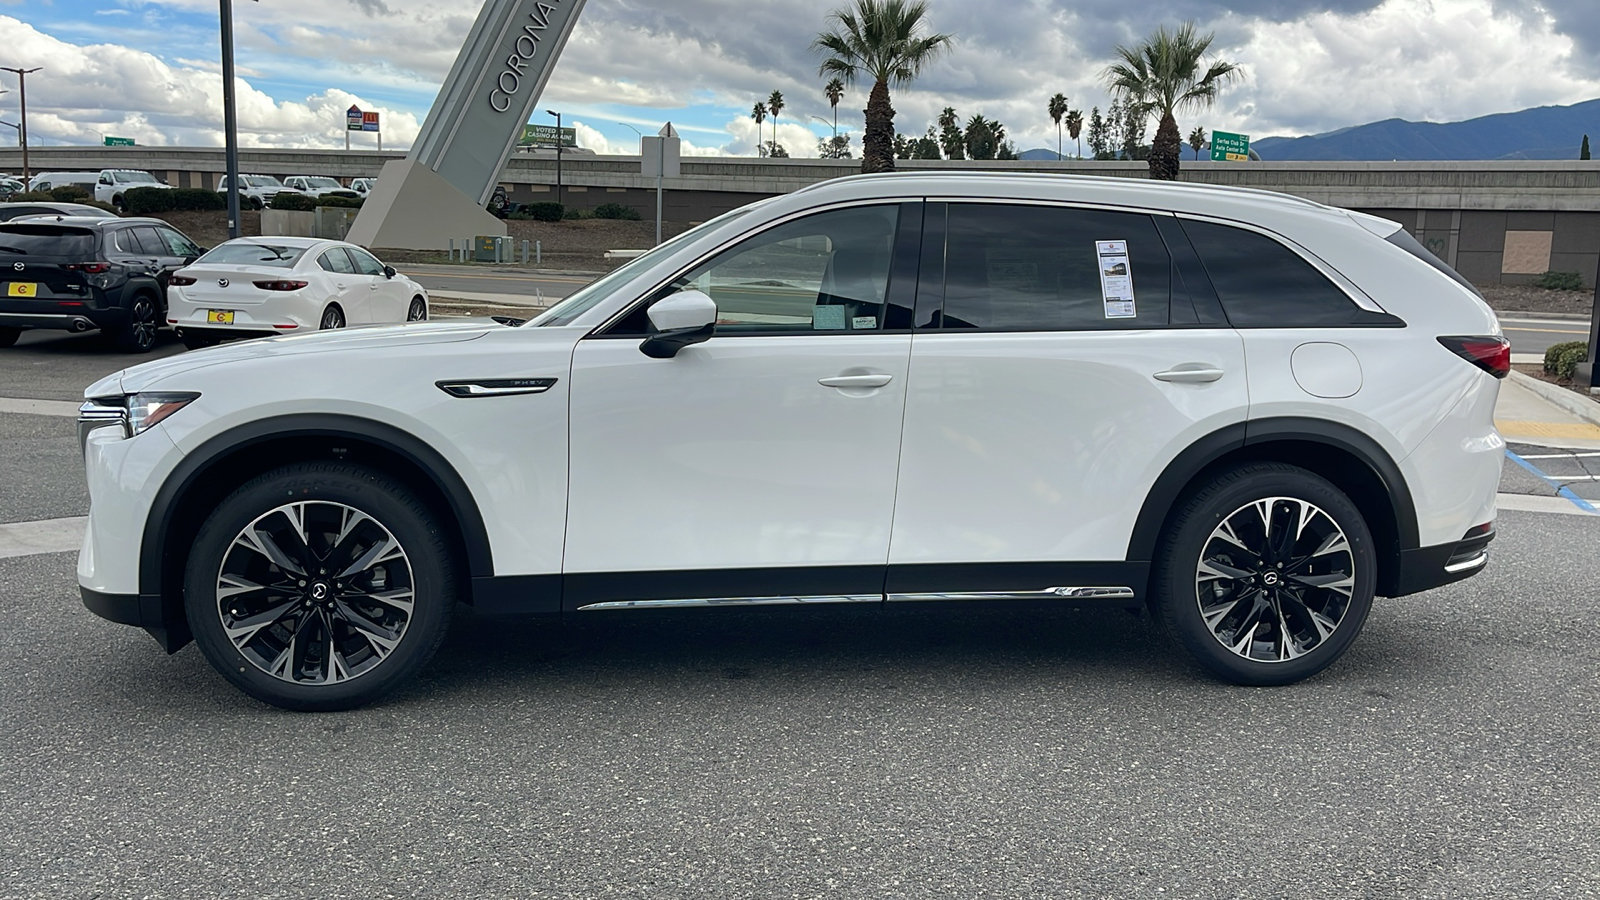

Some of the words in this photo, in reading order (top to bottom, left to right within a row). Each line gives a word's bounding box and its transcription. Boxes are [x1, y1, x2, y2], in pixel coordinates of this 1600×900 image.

[489, 1, 557, 112] CORONA
[535, 126, 557, 134] VOTED
[527, 131, 551, 139] CASINO
[1216, 137, 1230, 145] Serfas
[1226, 145, 1239, 153] Center
